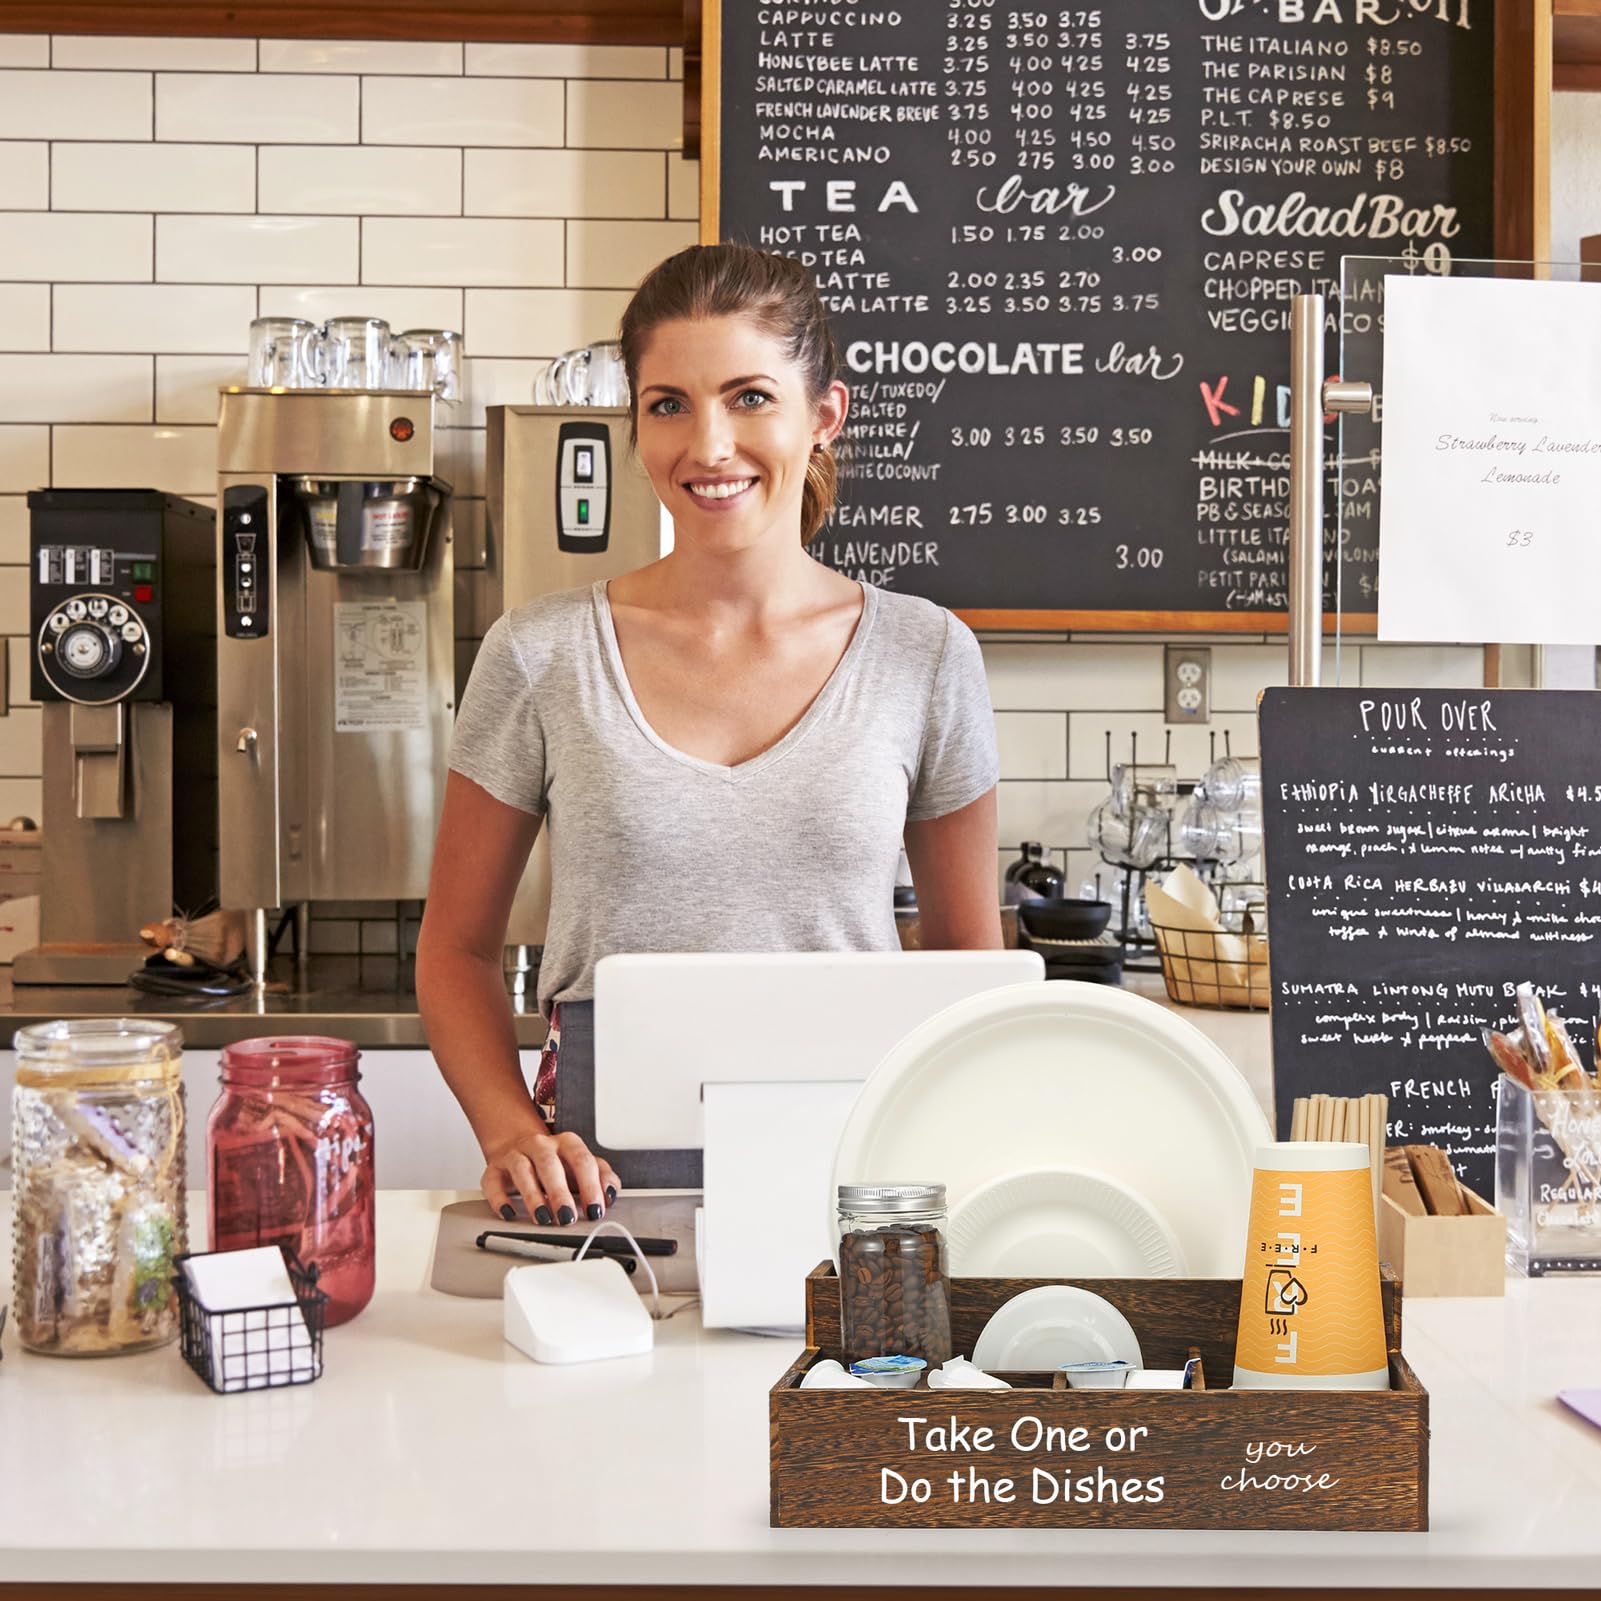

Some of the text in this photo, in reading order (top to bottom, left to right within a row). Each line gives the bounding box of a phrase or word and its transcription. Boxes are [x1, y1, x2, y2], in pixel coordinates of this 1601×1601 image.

[758, 10, 1101, 30] CAPPUCCINO 3.25 3.50 3.75
[761, 31, 1170, 52] LATTE 3.25 3.50 3.75 3.75
[1201, 35, 1421, 56] THE ITALIANO $8.50
[759, 52, 852, 71] HONEYBEE
[860, 56, 918, 71] LATTE
[944, 56, 989, 73] 3.75
[1202, 61, 1392, 84] THE PARISIAN $8
[755, 76, 814, 92] SALTED
[817, 79, 886, 96] CARAMEL
[891, 81, 936, 96] LATTE
[945, 80, 986, 96] 3.75
[1203, 87, 1394, 110] THE CAPRESE $9
[756, 102, 812, 117] FRENCH
[817, 104, 892, 122] LAVENDER
[897, 105, 939, 122] BREVE
[948, 104, 989, 120] 3.75
[1269, 109, 1330, 129] $8.50
[760, 125, 834, 140] MOCHA
[948, 128, 991, 145] 4.00
[1071, 131, 1111, 148] 4.50
[1132, 135, 1175, 152] 4.50
[1200, 133, 1470, 158] SRIRACHA ROAST BEEF $8.50
[759, 145, 1174, 174] AMERICANO 2.50 3.00 3.00
[1201, 158, 1404, 181] DESIGN YOUR OWN $8
[770, 175, 1115, 216] TEA bar
[1201, 190, 1460, 238] Salad Bar
[761, 224, 1104, 244] HOT TEA 1.50 1.75 2.00
[821, 249, 865, 266] TEA
[1113, 247, 1161, 263] 3.00
[1204, 251, 1325, 271] CAPRESE
[816, 271, 1100, 290] LATTE 2.00 2.35 2.70
[1204, 278, 1301, 300] CHOPPED
[820, 295, 1159, 313] TEA LATTE 3.25 3.50 3.75 3.75
[1208, 309, 1291, 332] VEGGI
[846, 341, 1183, 380] CHOCOLATE bar
[850, 403, 907, 418] SALTED
[952, 427, 1152, 447] 3.00 3.50 3.50
[1435, 434, 1527, 455] Strawberry
[876, 463, 941, 482] COCONUT
[1481, 466, 1560, 484] Lemonade
[1005, 505, 1046, 523] 3.00
[1058, 507, 1101, 524] 3.25
[1197, 503, 1220, 521] PB
[1198, 528, 1261, 545] LITTLE
[1506, 529, 1534, 546] $3
[834, 542, 939, 567] LAVENDER
[1116, 545, 1163, 569] 3.00
[1360, 697, 1496, 731] POUR OVER
[1394, 878, 1466, 894] HERBAZU
[1282, 982, 1358, 995] SUMATRA
[1456, 983, 1493, 997] MUTU
[1301, 1033, 1342, 1044] sweet
[1390, 1078, 1471, 1099] FRENCH
[898, 1416, 1148, 1453] Take One or
[1245, 1438, 1316, 1464] you
[881, 1466, 1164, 1504] Do the Dishes
[1220, 1467, 1340, 1492] choose
